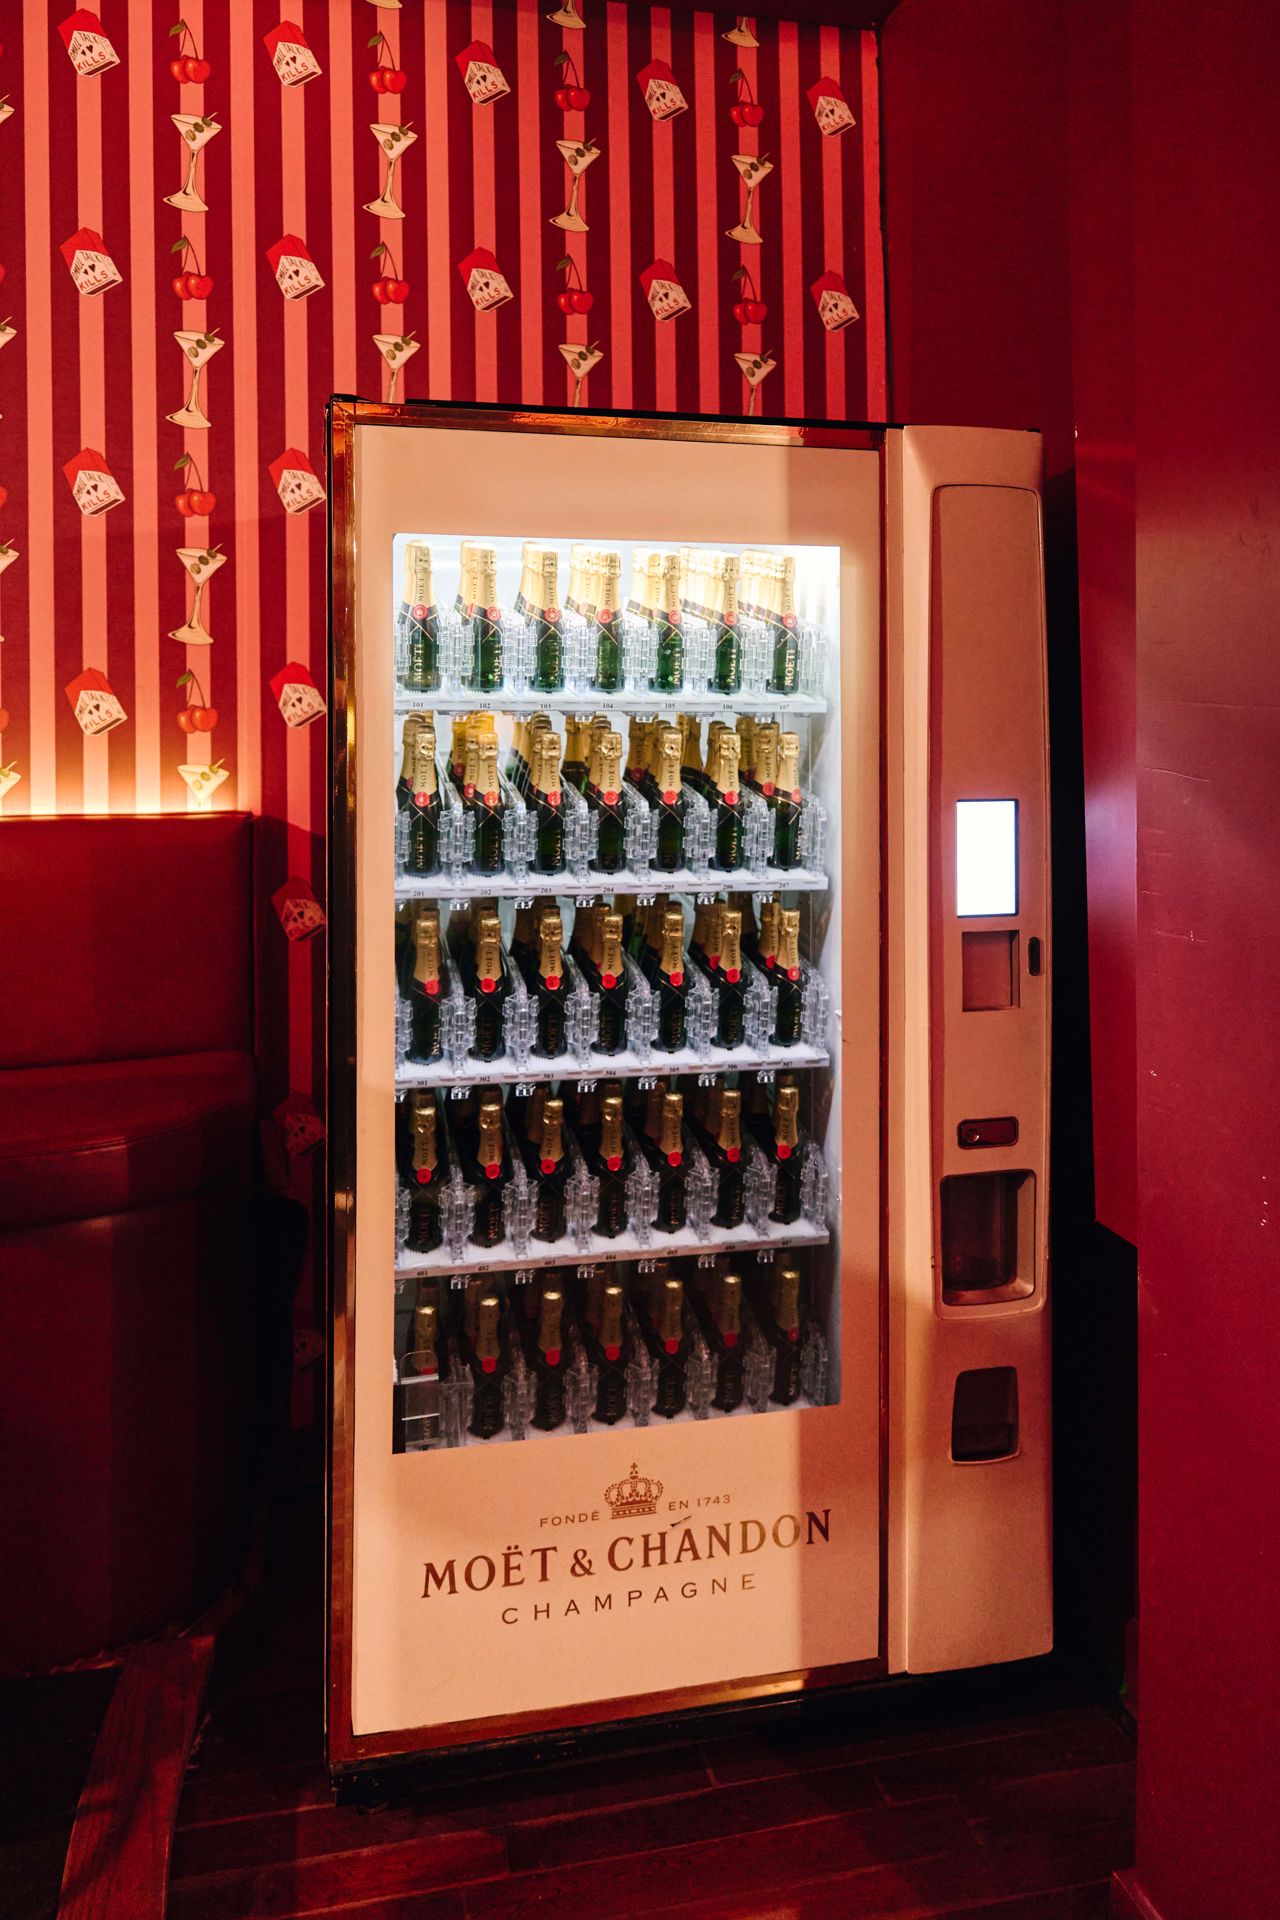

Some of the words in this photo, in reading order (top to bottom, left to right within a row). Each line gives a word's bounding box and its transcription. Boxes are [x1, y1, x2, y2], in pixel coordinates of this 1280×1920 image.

[76, 51, 106, 71] KILLS
[281, 62, 309, 82] KILLS
[471, 81, 499, 100] KILLS
[652, 97, 677, 116] KILLS
[821, 114, 845, 131] KILLS
[79, 270, 109, 291] KILLS
[283, 275, 312, 295] KILLS
[475, 287, 502, 307] KILLS
[654, 298, 680, 316] KILLS
[824, 308, 849, 326] KILLS
[81, 489, 112, 510] KILLS
[285, 488, 315, 509] KILLS
[83, 709, 114, 730] KILLS
[286, 702, 315, 723] KILLS
[539, 1509, 600, 1528] FONDÉ
[668, 1500, 690, 1512] EN
[697, 1494, 731, 1507] 1743
[421, 1545, 558, 1599] MOËT
[569, 1548, 596, 1578] &
[607, 1508, 832, 1572] CHANDON
[501, 1573, 756, 1625] CHAMPAGNE
